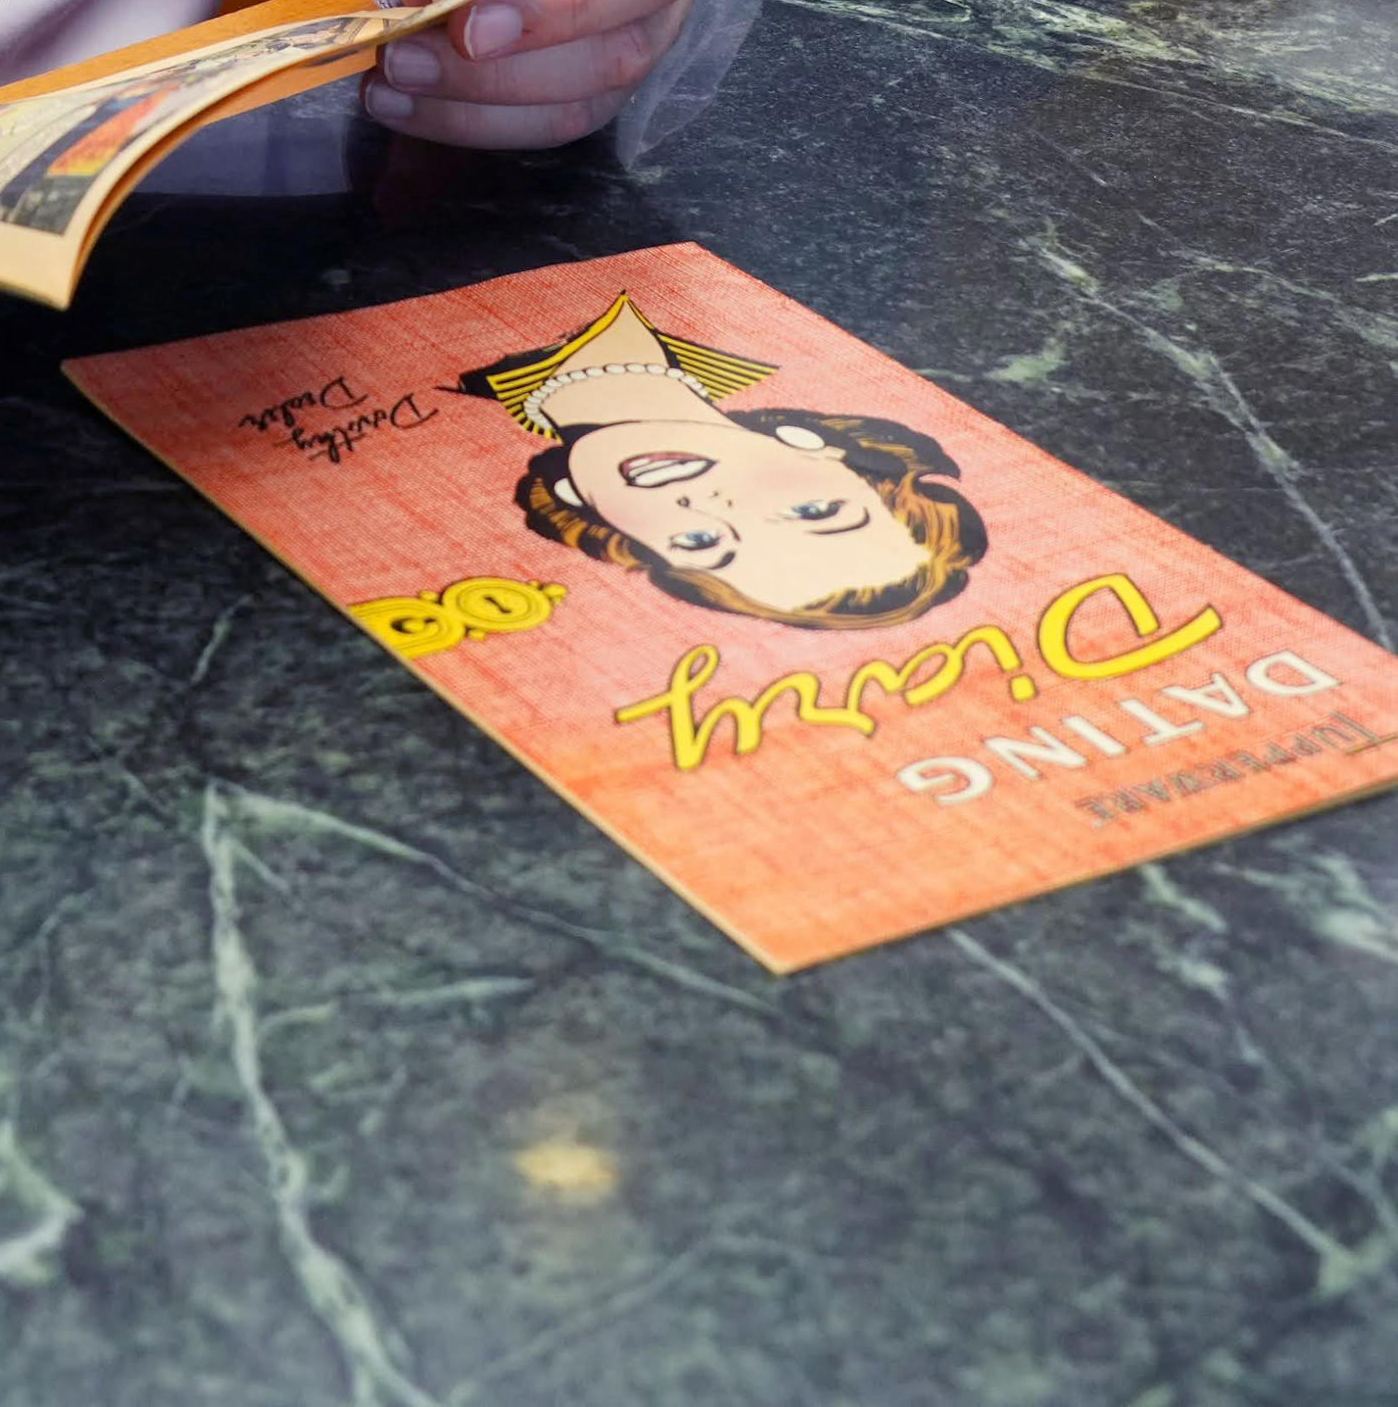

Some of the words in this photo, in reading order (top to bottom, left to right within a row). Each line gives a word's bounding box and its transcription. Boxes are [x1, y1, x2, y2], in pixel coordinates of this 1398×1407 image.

[238, 375, 369, 432] Dealer
[271, 392, 439, 464] Dorothy
[615, 572, 1222, 770] Diary
[895, 649, 1343, 806] DATING
[1077, 709, 1398, 829] TUPPERWARE
